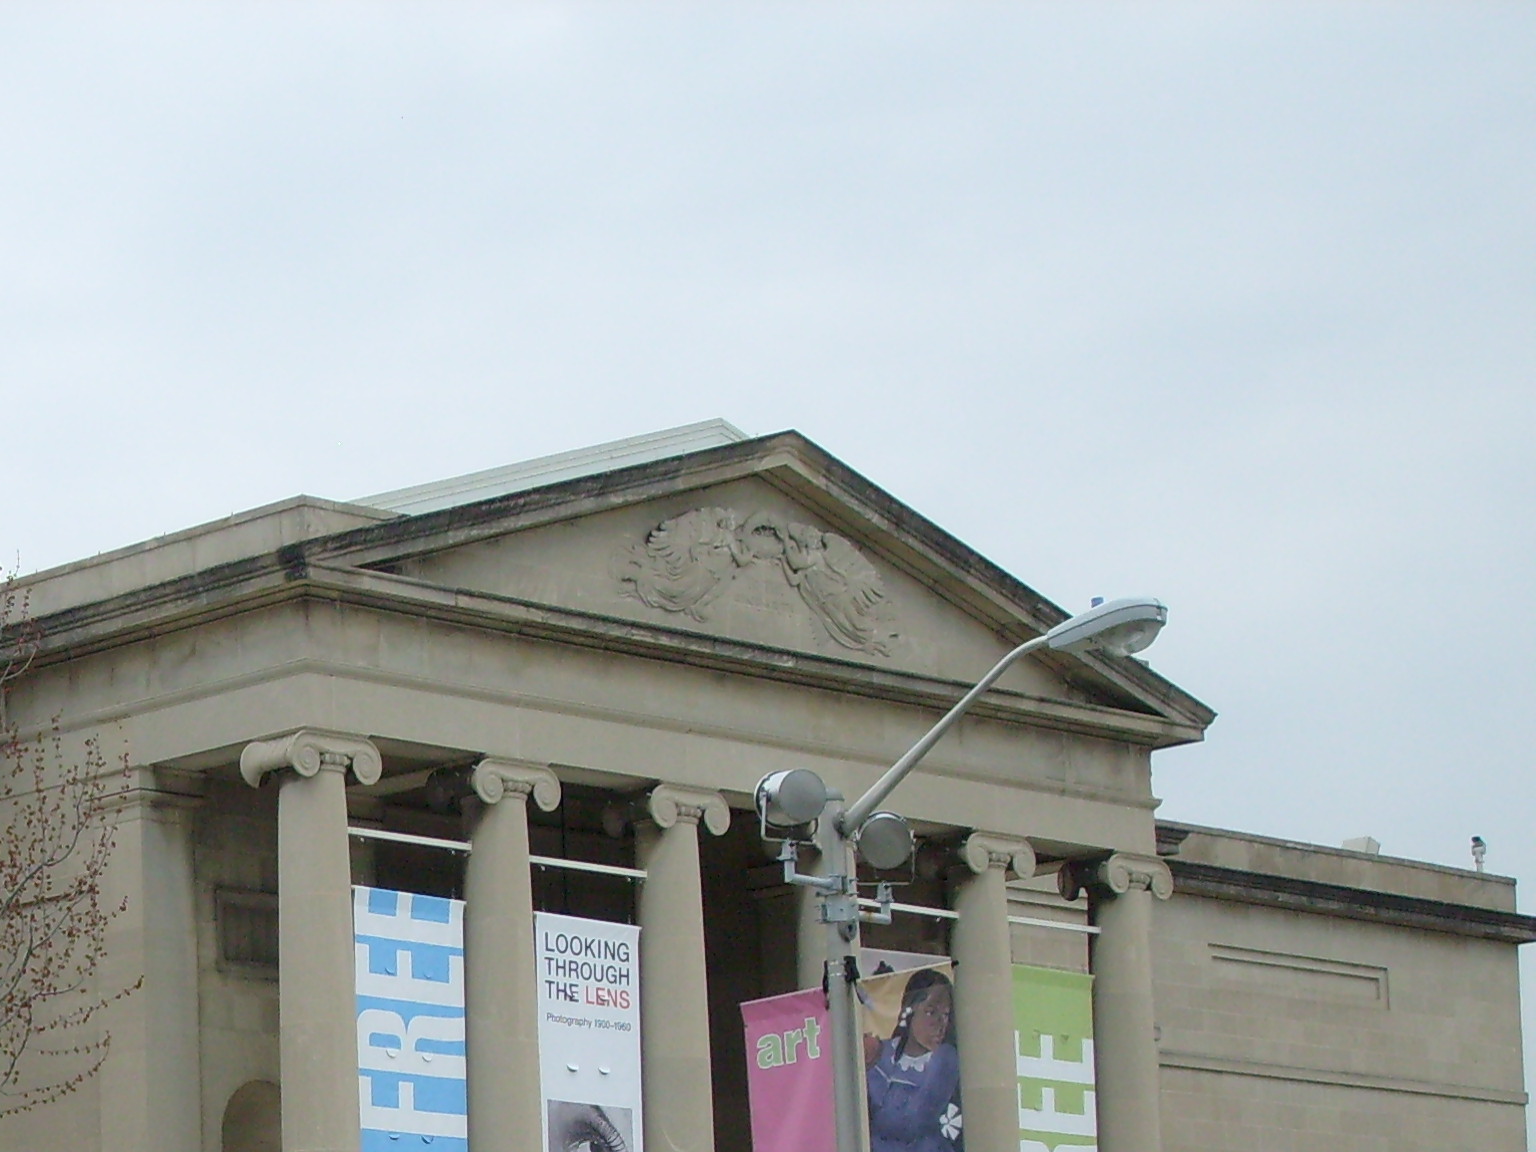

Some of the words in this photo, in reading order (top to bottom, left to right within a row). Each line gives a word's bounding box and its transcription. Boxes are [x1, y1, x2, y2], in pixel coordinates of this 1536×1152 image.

[544, 931, 630, 963] LOOKING
[544, 956, 630, 986] THROUGH
[544, 979, 580, 1003] THE
[585, 985, 631, 1010] LENS
[354, 886, 468, 1139] FREE
[546, 1011, 593, 1030] Photography
[756, 1016, 822, 1069] art
